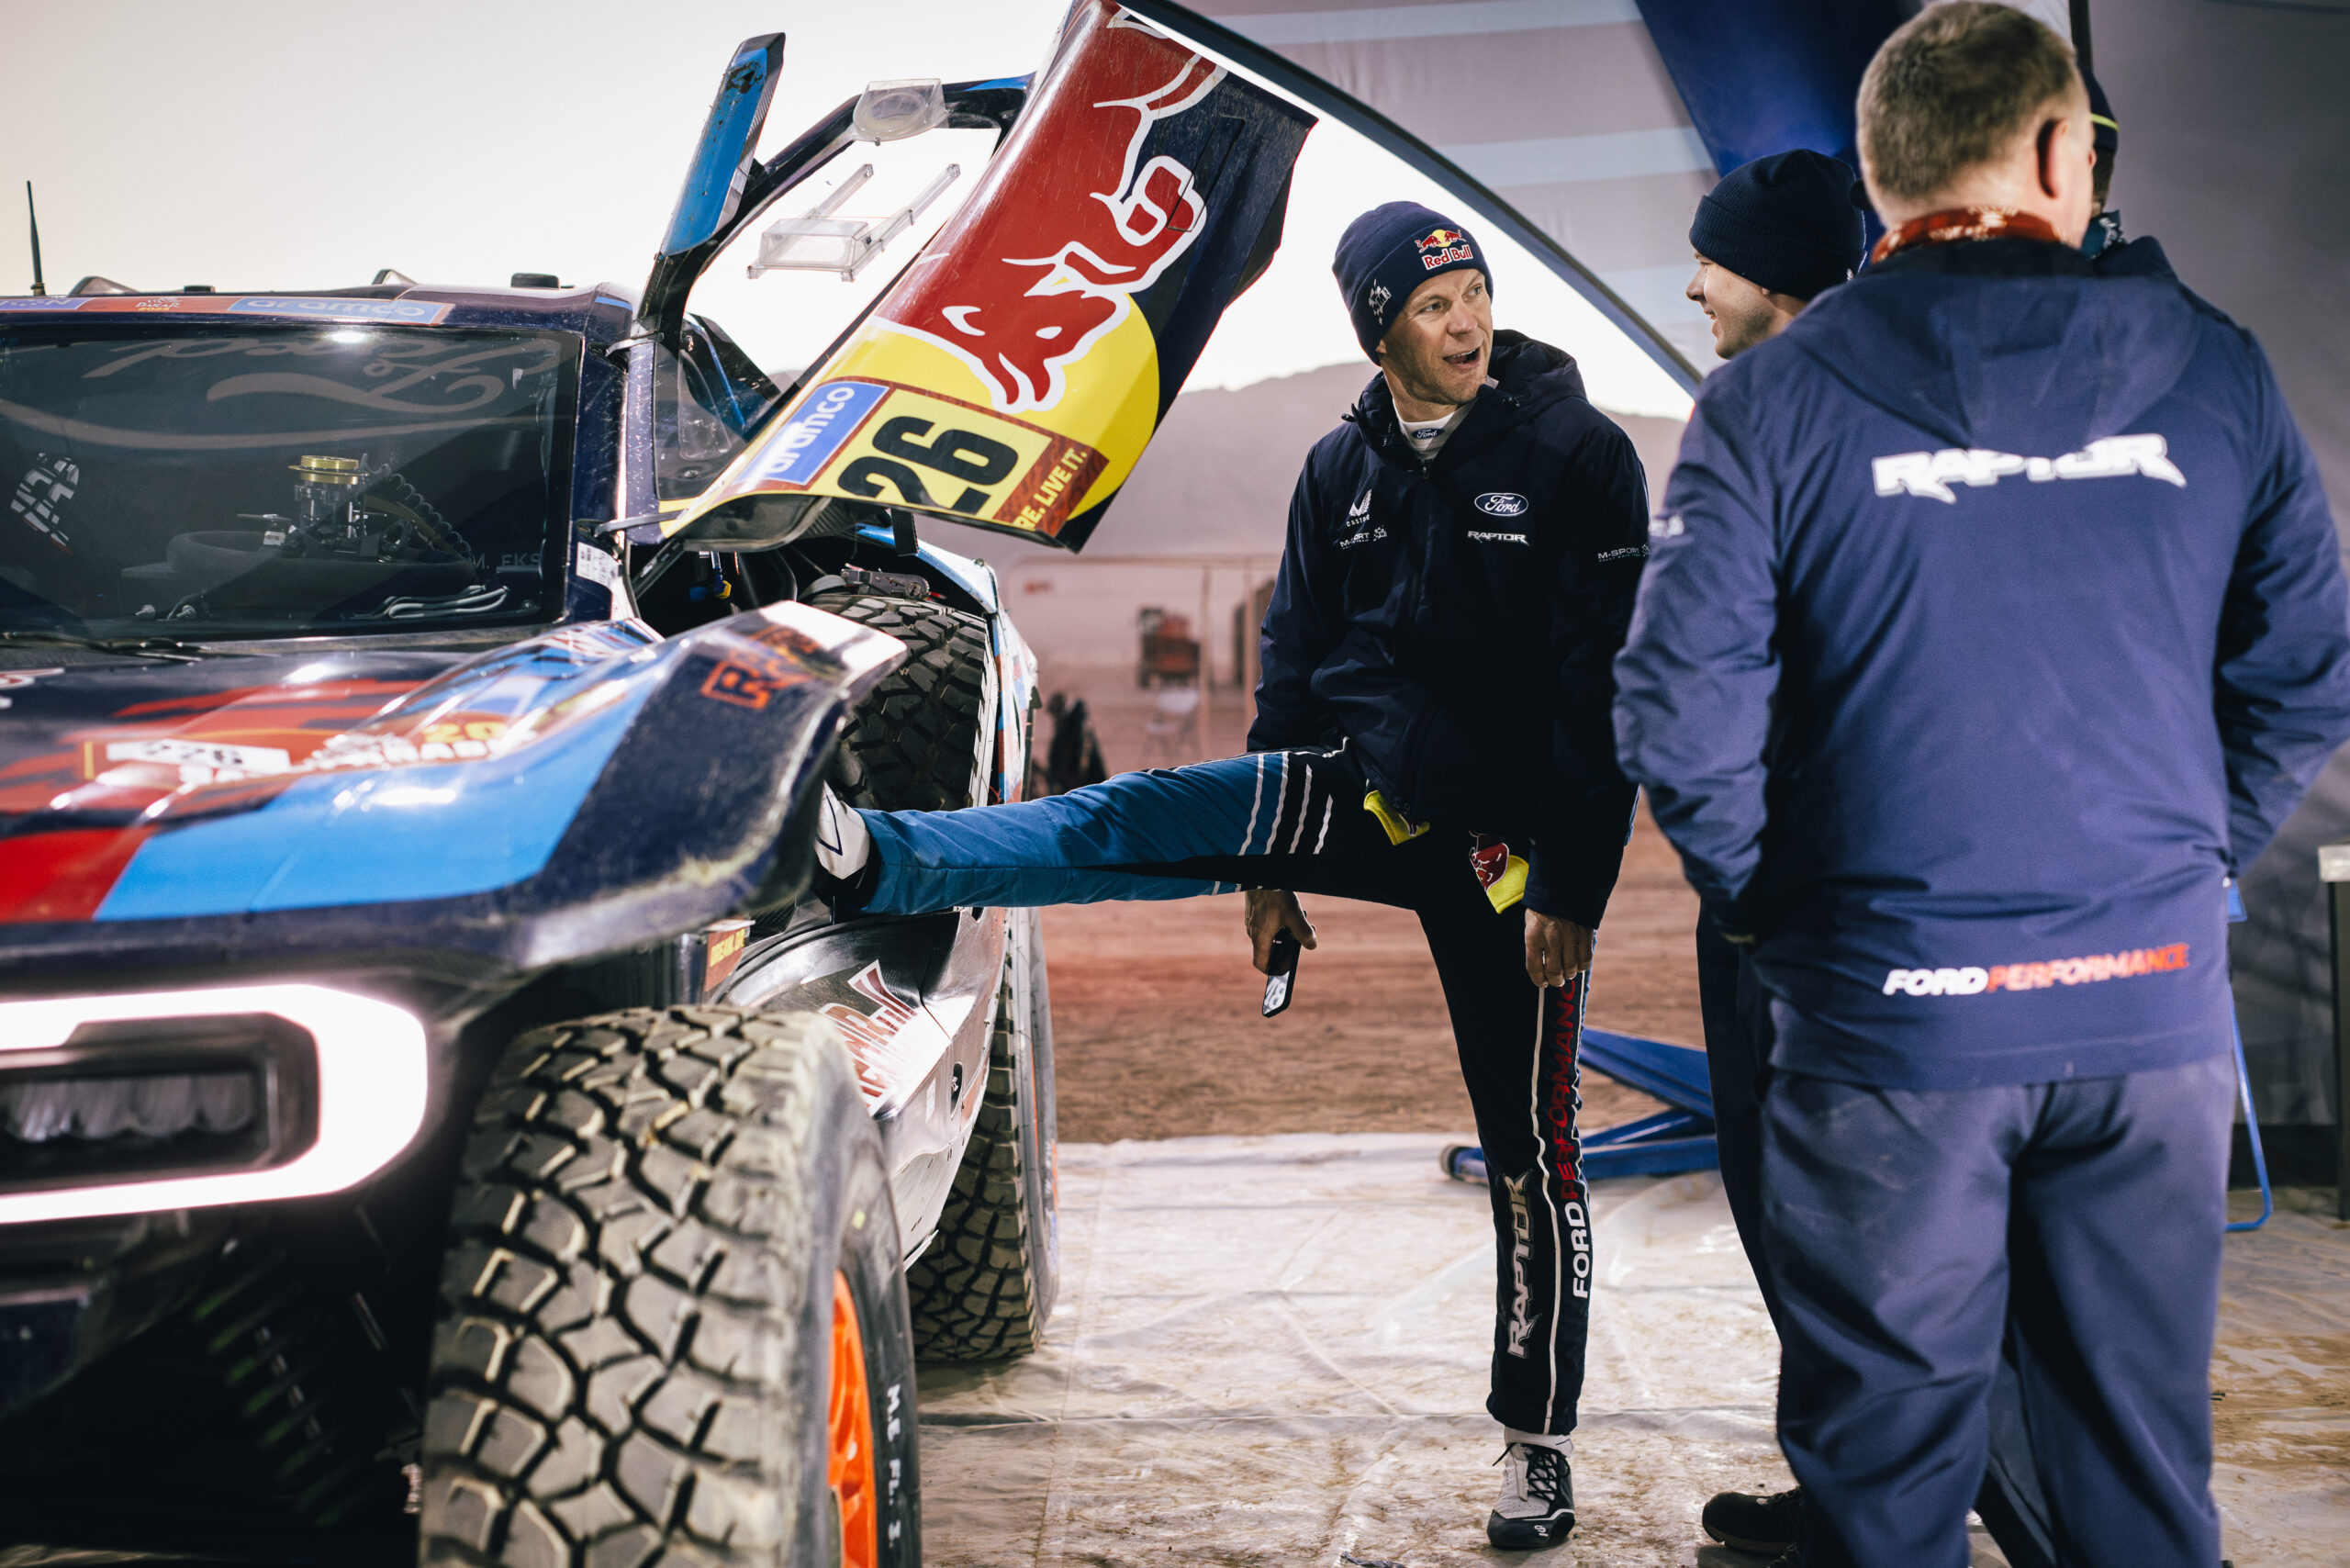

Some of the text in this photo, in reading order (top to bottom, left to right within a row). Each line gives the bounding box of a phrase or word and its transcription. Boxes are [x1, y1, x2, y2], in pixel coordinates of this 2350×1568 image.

[1422, 244, 1473, 270] Red Bull
[247, 298, 426, 317] aramco
[762, 386, 856, 474] aramco
[1416, 429, 1438, 439] Ford
[1033, 465, 1073, 508] LIVE
[1060, 447, 1088, 471] IT.
[1873, 433, 2188, 504] RAPTOR
[1484, 495, 1522, 513] Ford
[1468, 531, 1530, 546] RAPTOR
[1883, 942, 2190, 996] FORD PERFORMANCE
[1548, 980, 1578, 1200] PERFORMANC
[1506, 1169, 1544, 1359] RAPTOR
[1564, 1201, 1590, 1299] FORD
